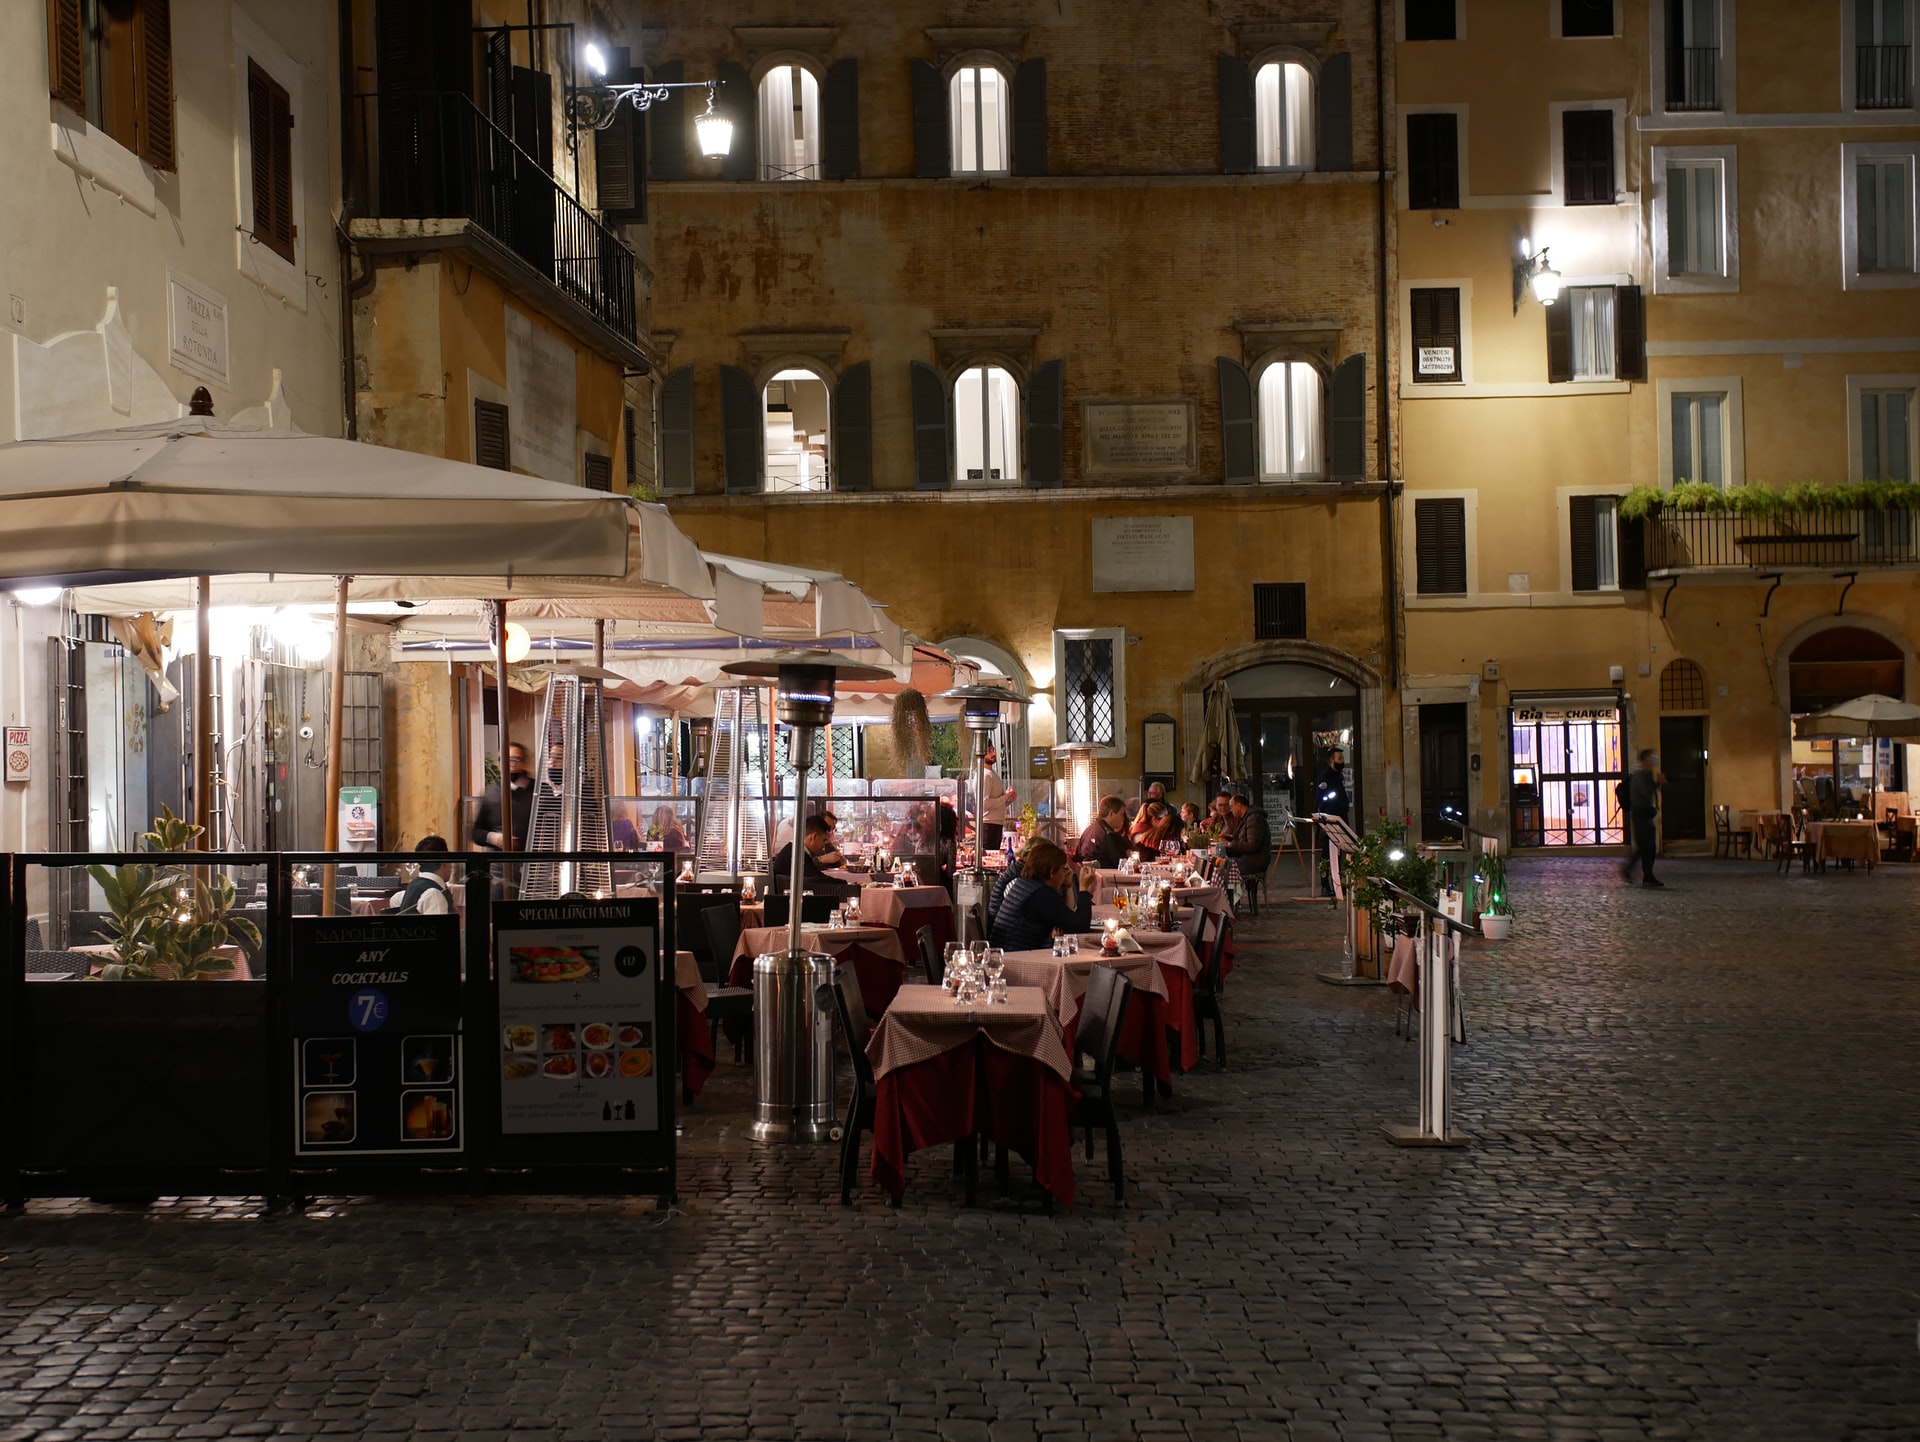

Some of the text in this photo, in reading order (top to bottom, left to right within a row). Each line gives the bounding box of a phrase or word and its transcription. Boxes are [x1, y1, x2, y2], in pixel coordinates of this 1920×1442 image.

[186, 296, 211, 321] PIAZZA
[182, 335, 218, 364] ROTONDA
[1519, 706, 1612, 720] Ria CHANGE
[10, 731, 28, 744] PIZZA
[518, 905, 631, 921] SPECIAL LUNCH MENU
[315, 926, 439, 941] NAPOLETANO'S
[356, 948, 390, 963] ANY
[331, 971, 409, 985] COCKTAILS
